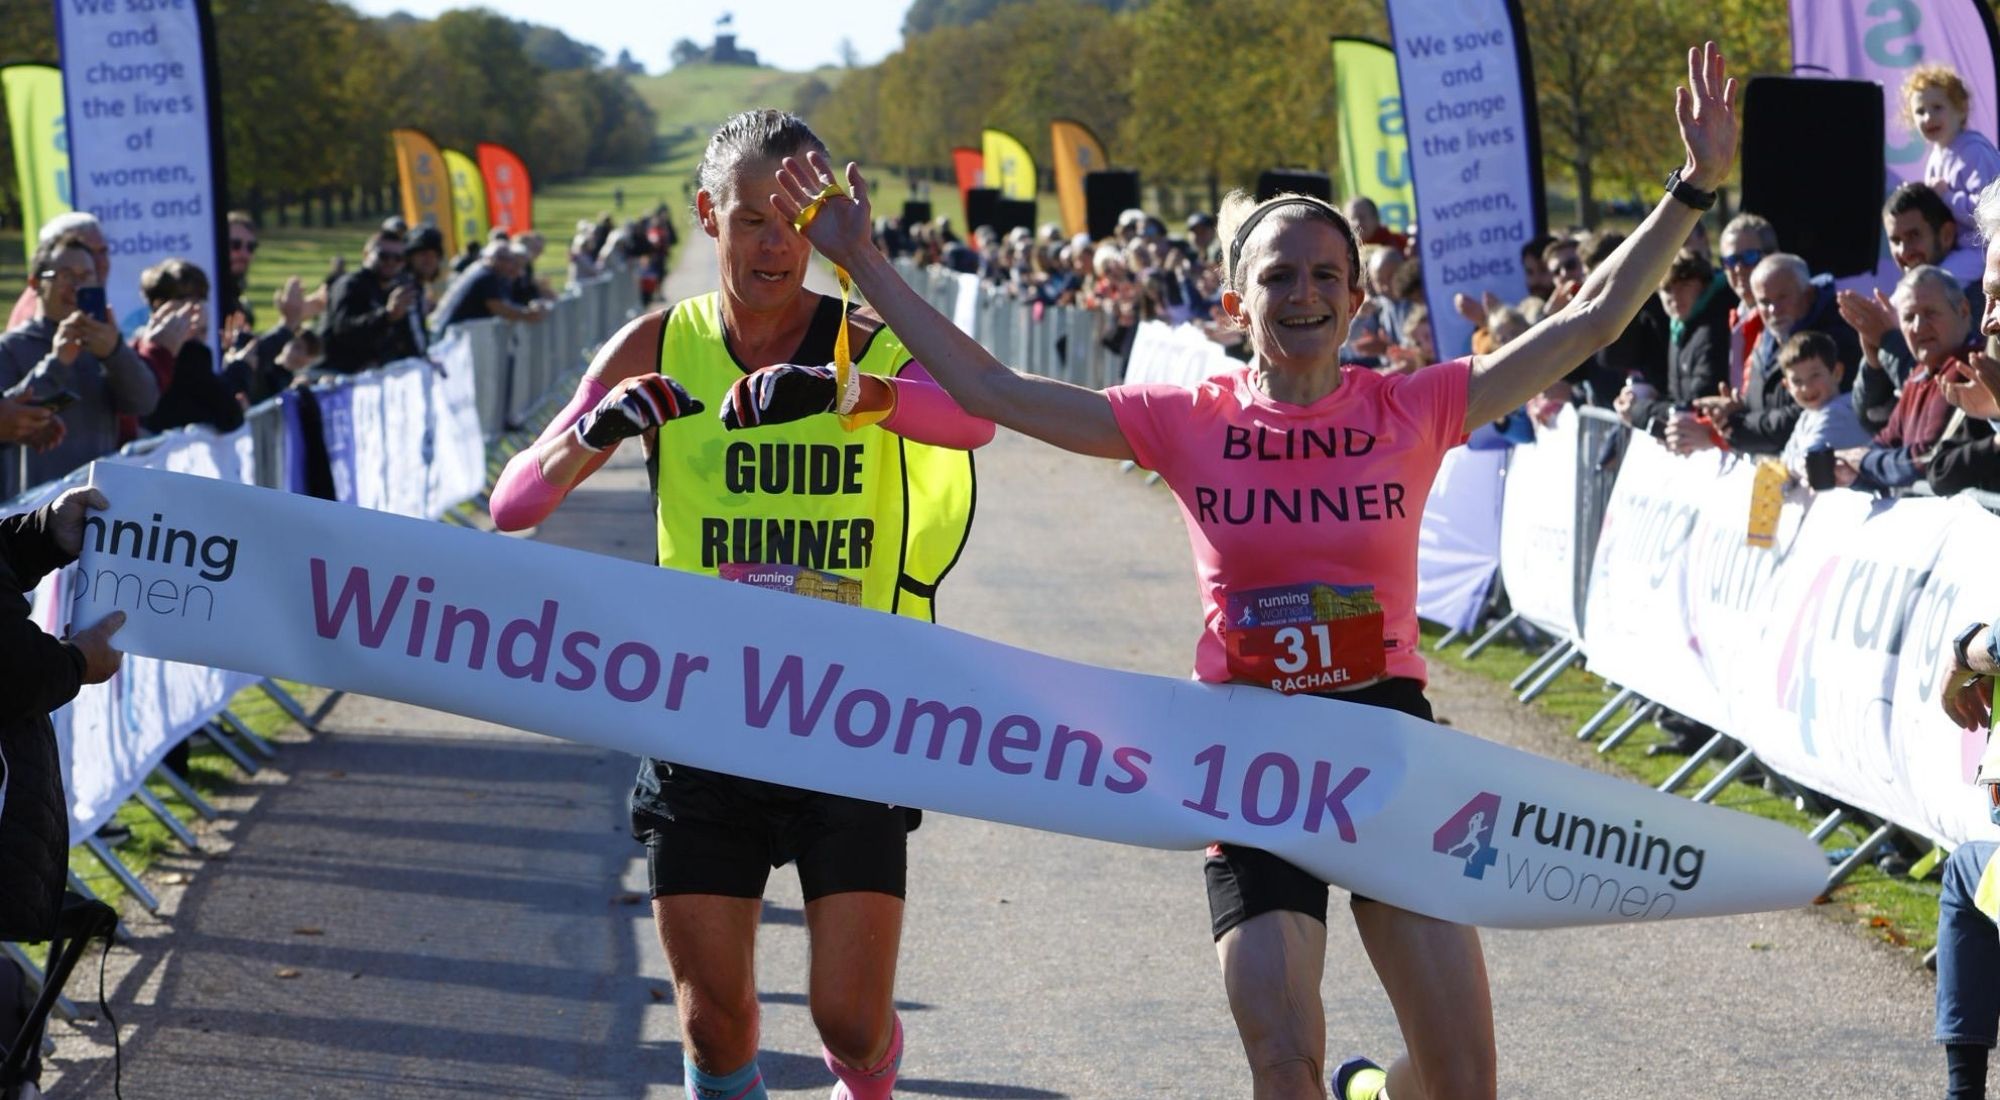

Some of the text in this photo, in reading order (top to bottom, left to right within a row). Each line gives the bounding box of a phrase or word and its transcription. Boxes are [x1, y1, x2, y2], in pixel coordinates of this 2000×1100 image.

[126, 0, 184, 13] save
[107, 24, 158, 48] and
[1406, 28, 1504, 59] We save
[86, 60, 184, 85] change
[1441, 62, 1483, 87] and
[82, 94, 194, 118] the lives
[1425, 94, 1506, 124] change
[126, 127, 153, 151] of
[1423, 127, 1515, 158] the lives
[90, 164, 195, 187] women,
[1461, 160, 1481, 183] of
[151, 195, 201, 218] and
[1432, 191, 1518, 222] women,
[1430, 221, 1524, 259] girls and
[1442, 257, 1515, 286] babies
[1223, 424, 1376, 461] BLIND
[725, 442, 864, 495] GUIDE
[1195, 482, 1406, 525] RUNNER
[701, 517, 875, 569] RUNNER
[748, 572, 794, 586] running
[1258, 592, 1310, 609] running
[1273, 624, 1332, 674] 31
[1272, 668, 1351, 692] RACHAEL
[310, 558, 1371, 844] Windsor Womens 10K
[1512, 801, 1705, 891] running
[1507, 852, 1677, 919] women
